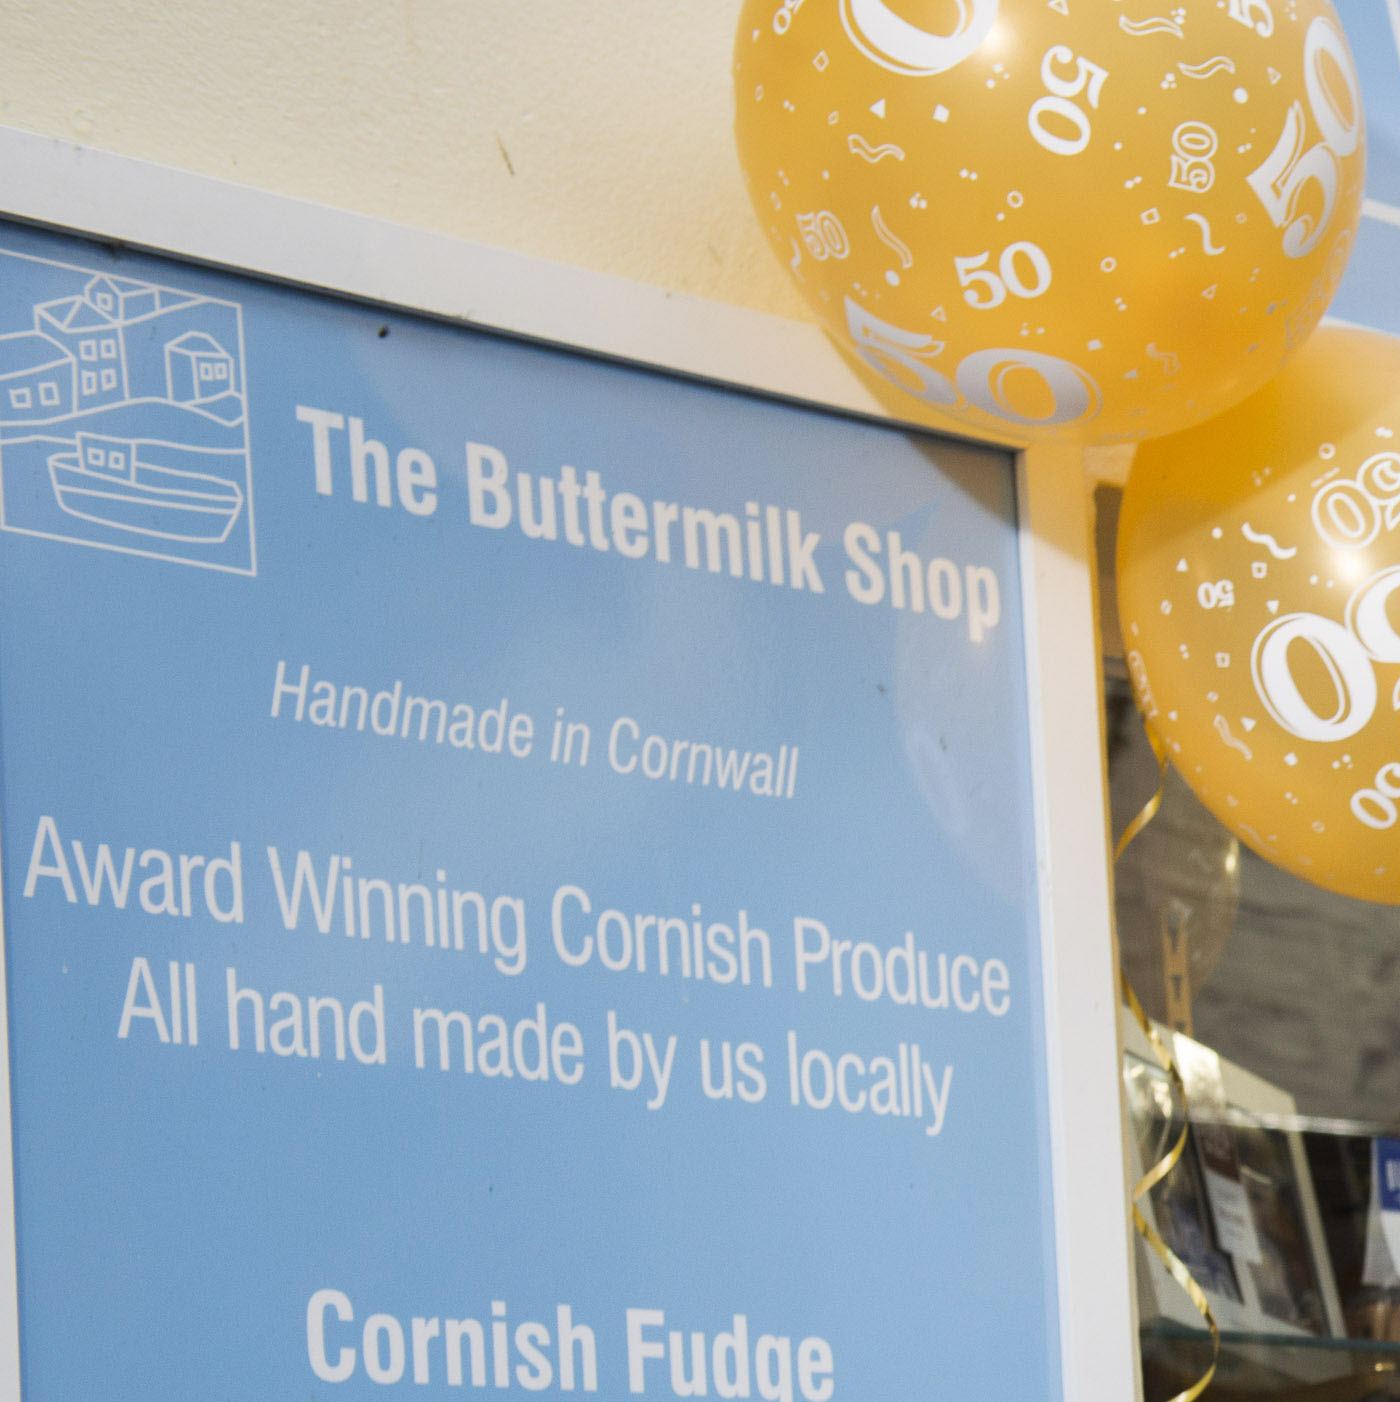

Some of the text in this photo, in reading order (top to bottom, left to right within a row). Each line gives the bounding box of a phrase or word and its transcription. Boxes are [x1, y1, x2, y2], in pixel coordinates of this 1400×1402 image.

[1028, 45, 1109, 156] 50
[1246, 16, 1360, 259] 50
[954, 241, 1052, 310] 50
[296, 405, 1001, 642] The Buttermilk Shop
[1197, 579, 1235, 609] 50
[270, 661, 799, 799] Handmade in Cornwall
[23, 815, 1011, 1017] Award Winning Cornish Produce
[117, 956, 953, 1137] All hand made by us locally
[306, 1289, 598, 1392] Cornish
